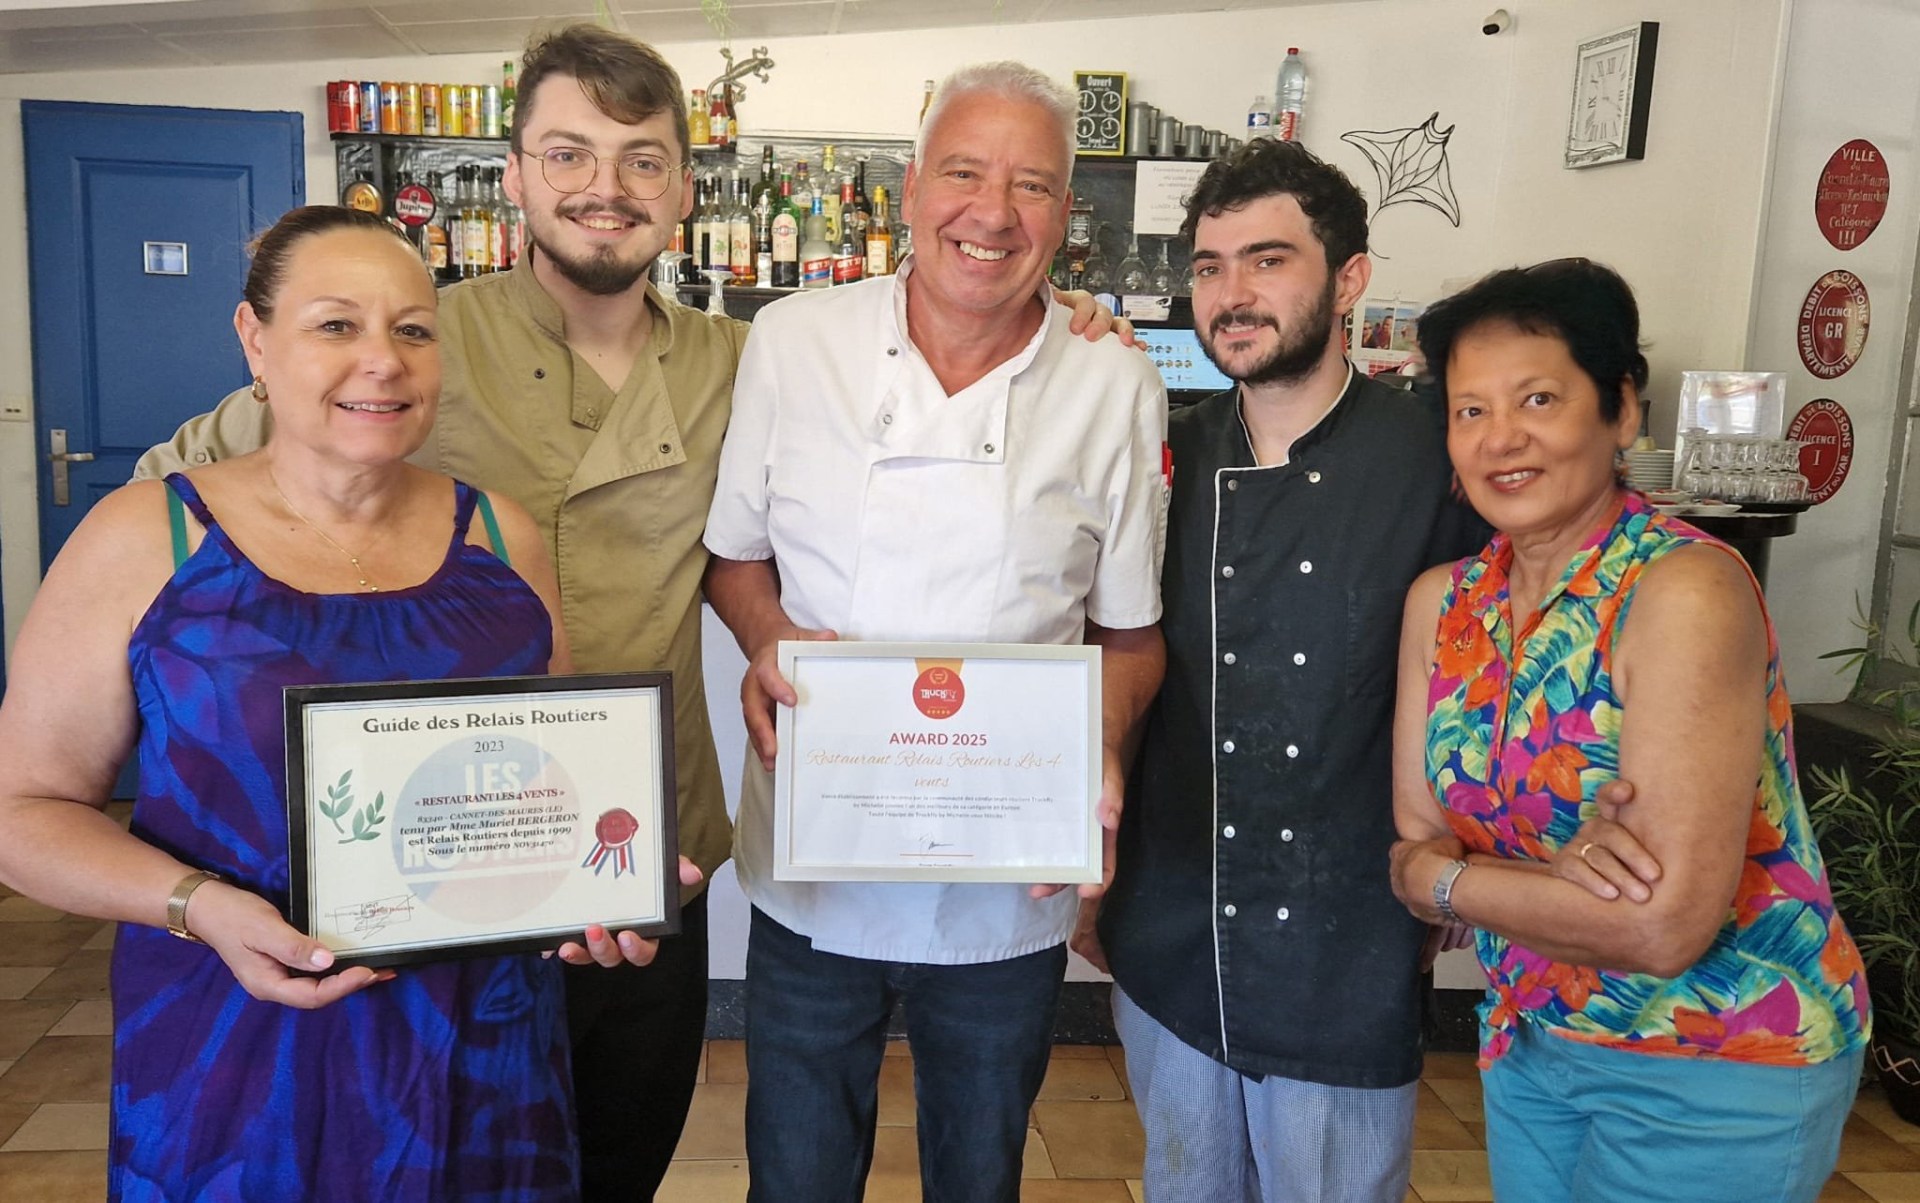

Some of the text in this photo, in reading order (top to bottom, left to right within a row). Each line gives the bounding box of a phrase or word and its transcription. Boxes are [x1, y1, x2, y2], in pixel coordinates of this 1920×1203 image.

[1841, 148, 1877, 162] VILLE
[1802, 286, 1822, 319] DEBIT
[1833, 272, 1867, 323] BOISSONS
[1824, 322, 1844, 339] GR
[1804, 434, 1837, 445] LICENCE
[1837, 455, 1850, 476] VAR
[363, 708, 608, 733] Guide des Relais Routiers
[474, 740, 505, 753] 2023
[889, 732, 987, 746] AWARD 2025
[805, 749, 1063, 769] Restaurant Relais Routiers Les 4
[914, 776, 950, 788] vents
[422, 793, 493, 807] RESTAURANT
[494, 791, 515, 801] LES
[516, 791, 523, 801] 4
[524, 788, 558, 799] VENTS
[545, 805, 563, 815] (LE)
[400, 813, 580, 837] tenu par Mme Muriel BERGERON
[408, 825, 572, 846] est Relais Routiers depuis 1999
[427, 846, 454, 856] Sous
[456, 844, 466, 854] le
[468, 840, 511, 853] numéro
